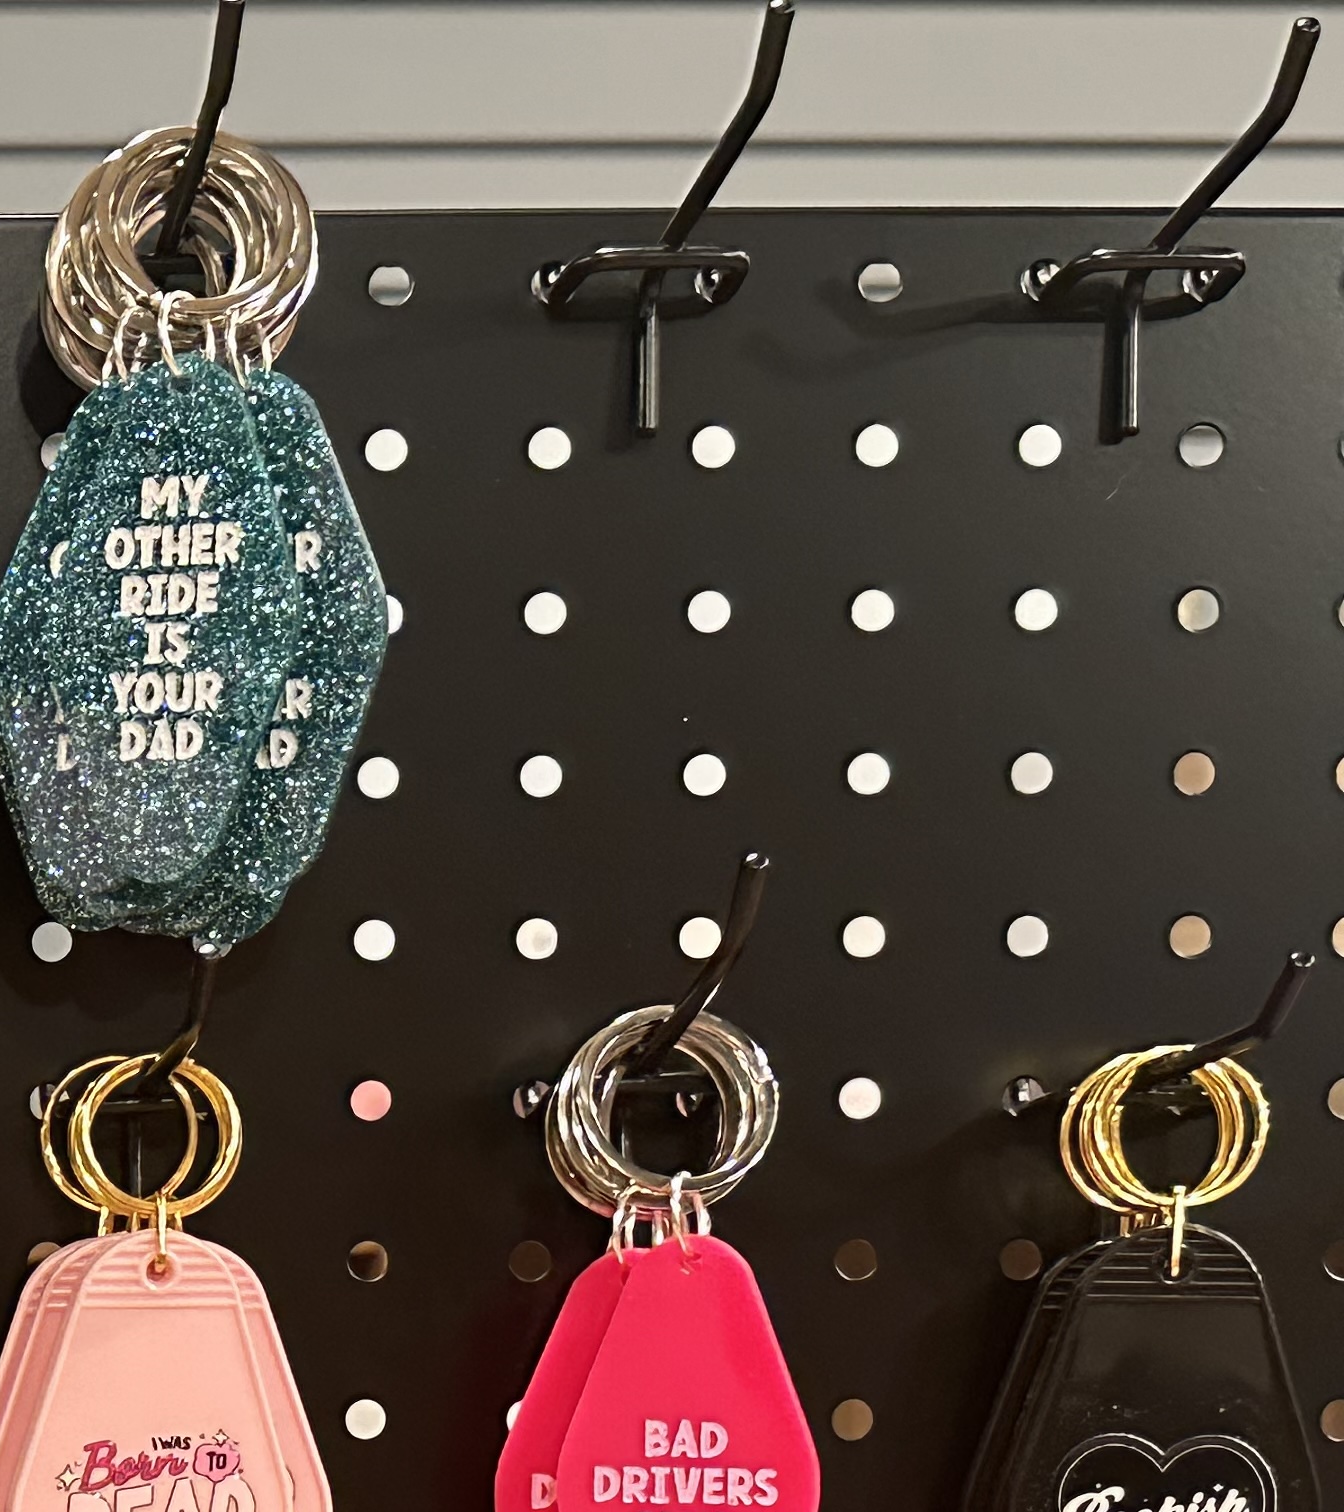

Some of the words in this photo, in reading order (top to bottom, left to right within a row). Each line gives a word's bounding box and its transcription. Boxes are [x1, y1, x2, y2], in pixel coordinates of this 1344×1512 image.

[141, 474, 210, 519] MY
[104, 521, 245, 570] OTHER
[120, 571, 220, 616] RIDE
[143, 621, 191, 666] IS
[110, 670, 224, 714] YOUR
[119, 717, 204, 762] DAD
[151, 1437, 158, 1451] I
[158, 1436, 192, 1450] WAS
[644, 1419, 729, 1459] BAD
[79, 1440, 188, 1492] Born
[206, 1451, 227, 1472] TO
[593, 1465, 779, 1507] DRIVERS
